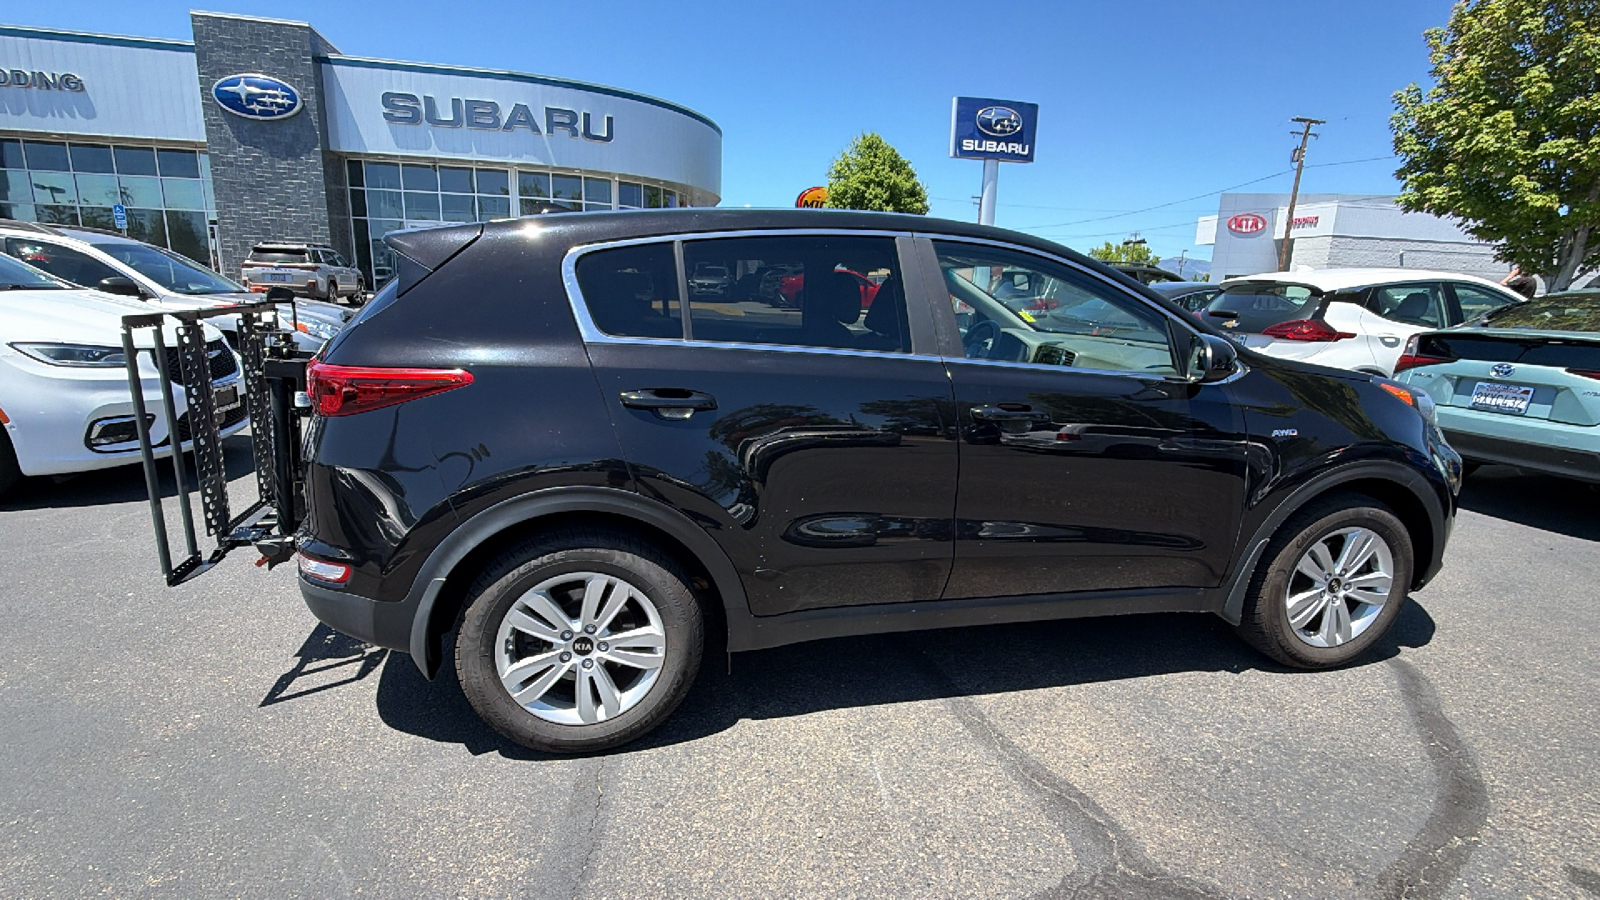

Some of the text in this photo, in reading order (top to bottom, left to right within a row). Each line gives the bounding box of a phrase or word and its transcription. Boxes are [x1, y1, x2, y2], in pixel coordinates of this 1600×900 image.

[381, 91, 615, 143] SUBARU
[962, 139, 1029, 155] SUBARU
[1234, 216, 1259, 229] KIA
[1271, 428, 1298, 437] AWD
[574, 642, 592, 651] KIA
